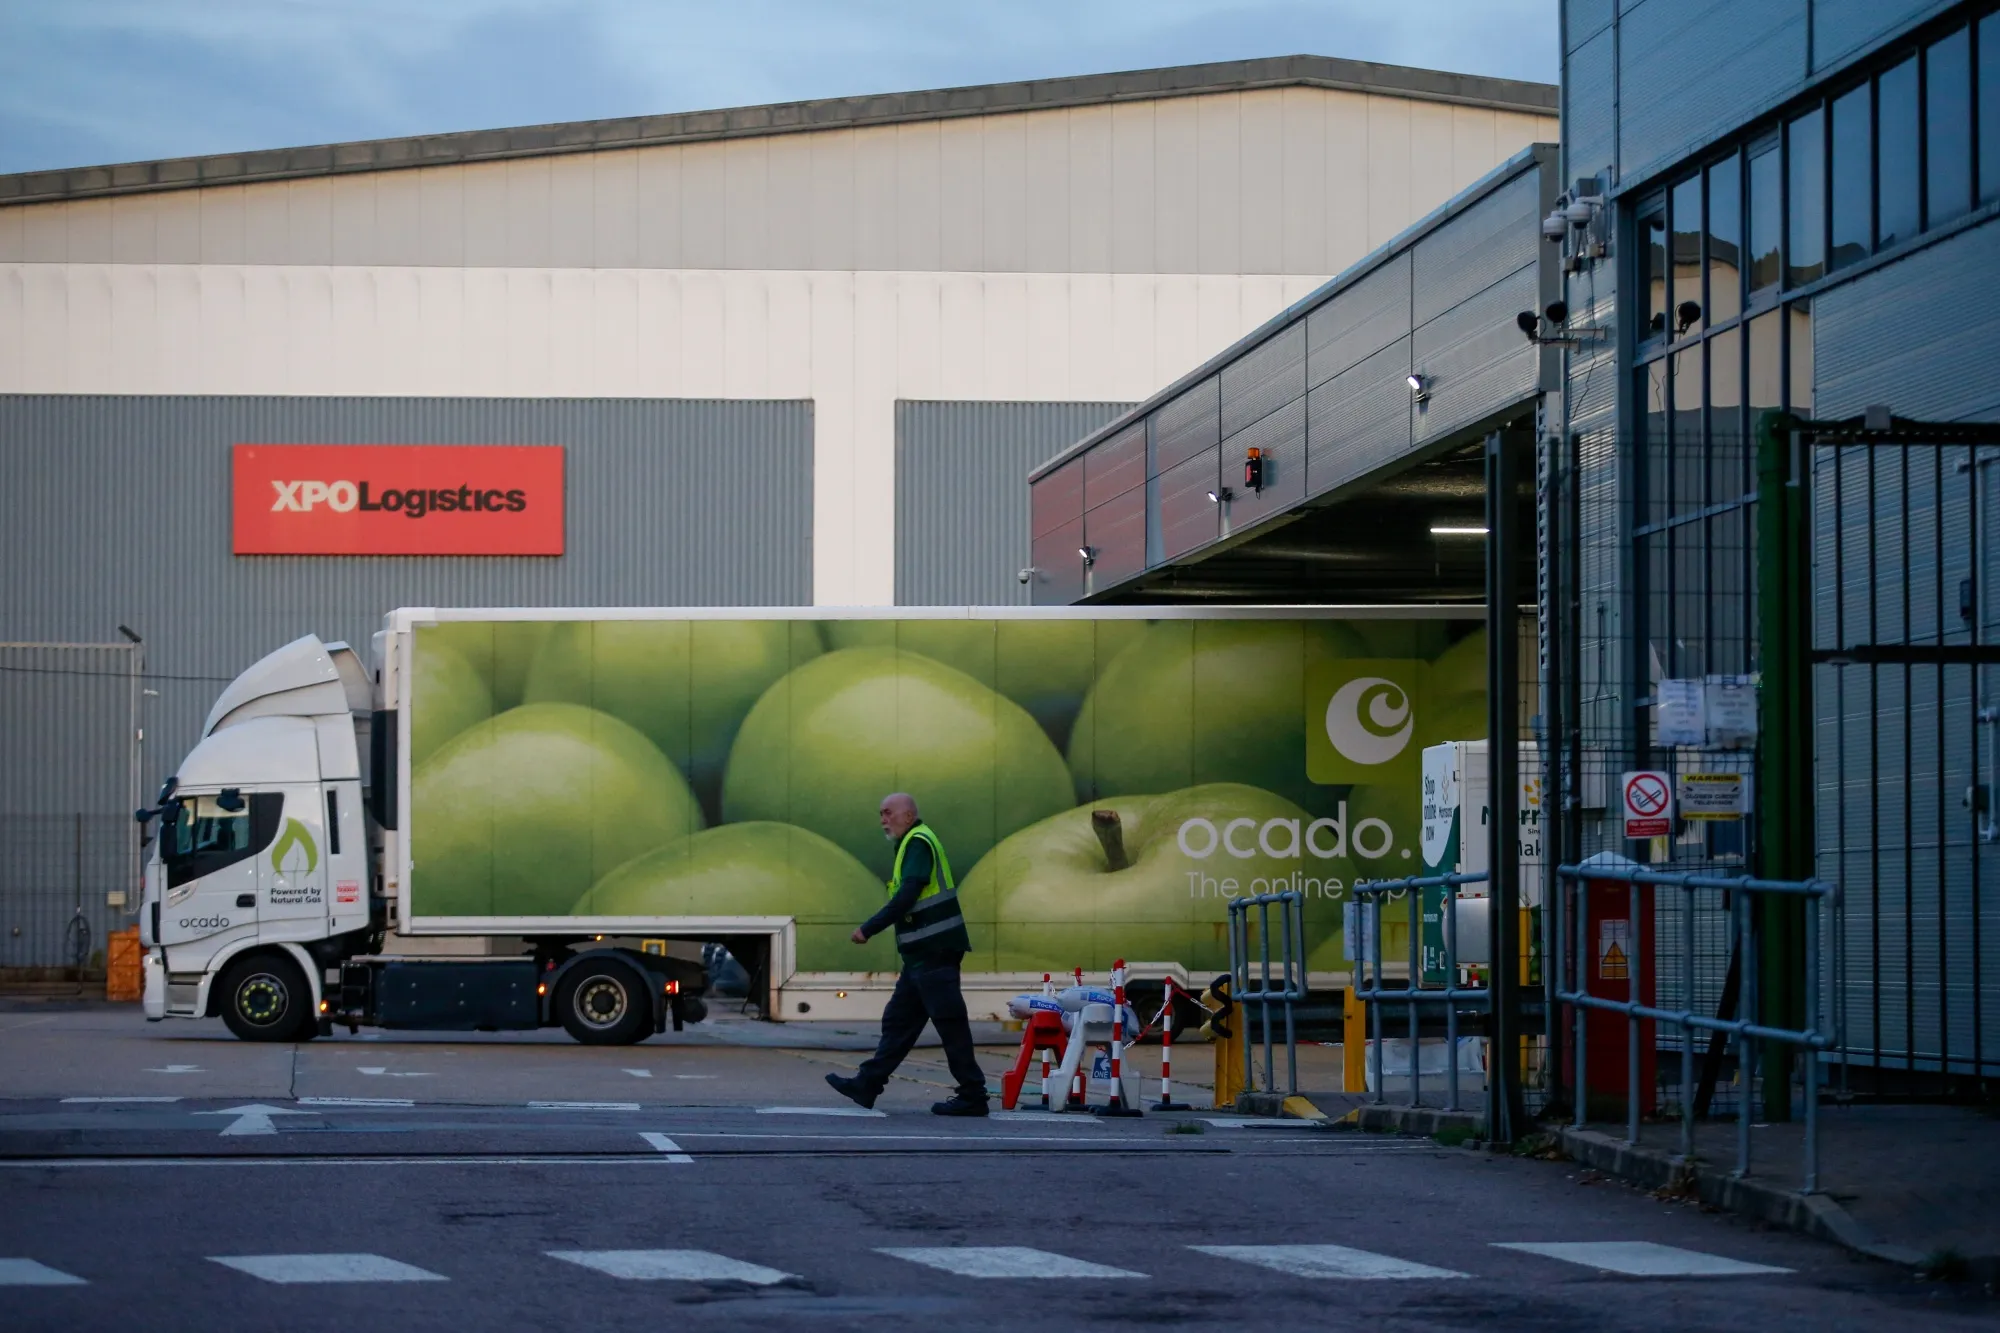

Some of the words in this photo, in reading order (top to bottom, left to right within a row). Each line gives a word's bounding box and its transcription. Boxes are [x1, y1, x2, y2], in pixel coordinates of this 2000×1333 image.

[1424, 773, 1436, 800] Shop
[1423, 799, 1437, 820] online
[270, 887, 308, 895] Powered
[311, 887, 322, 896] by
[1185, 871, 1239, 899] The
[1249, 871, 1343, 899] online
[270, 896, 303, 904] Natural
[179, 913, 230, 928] ocado
[1093, 1070, 1109, 1079] ONE
